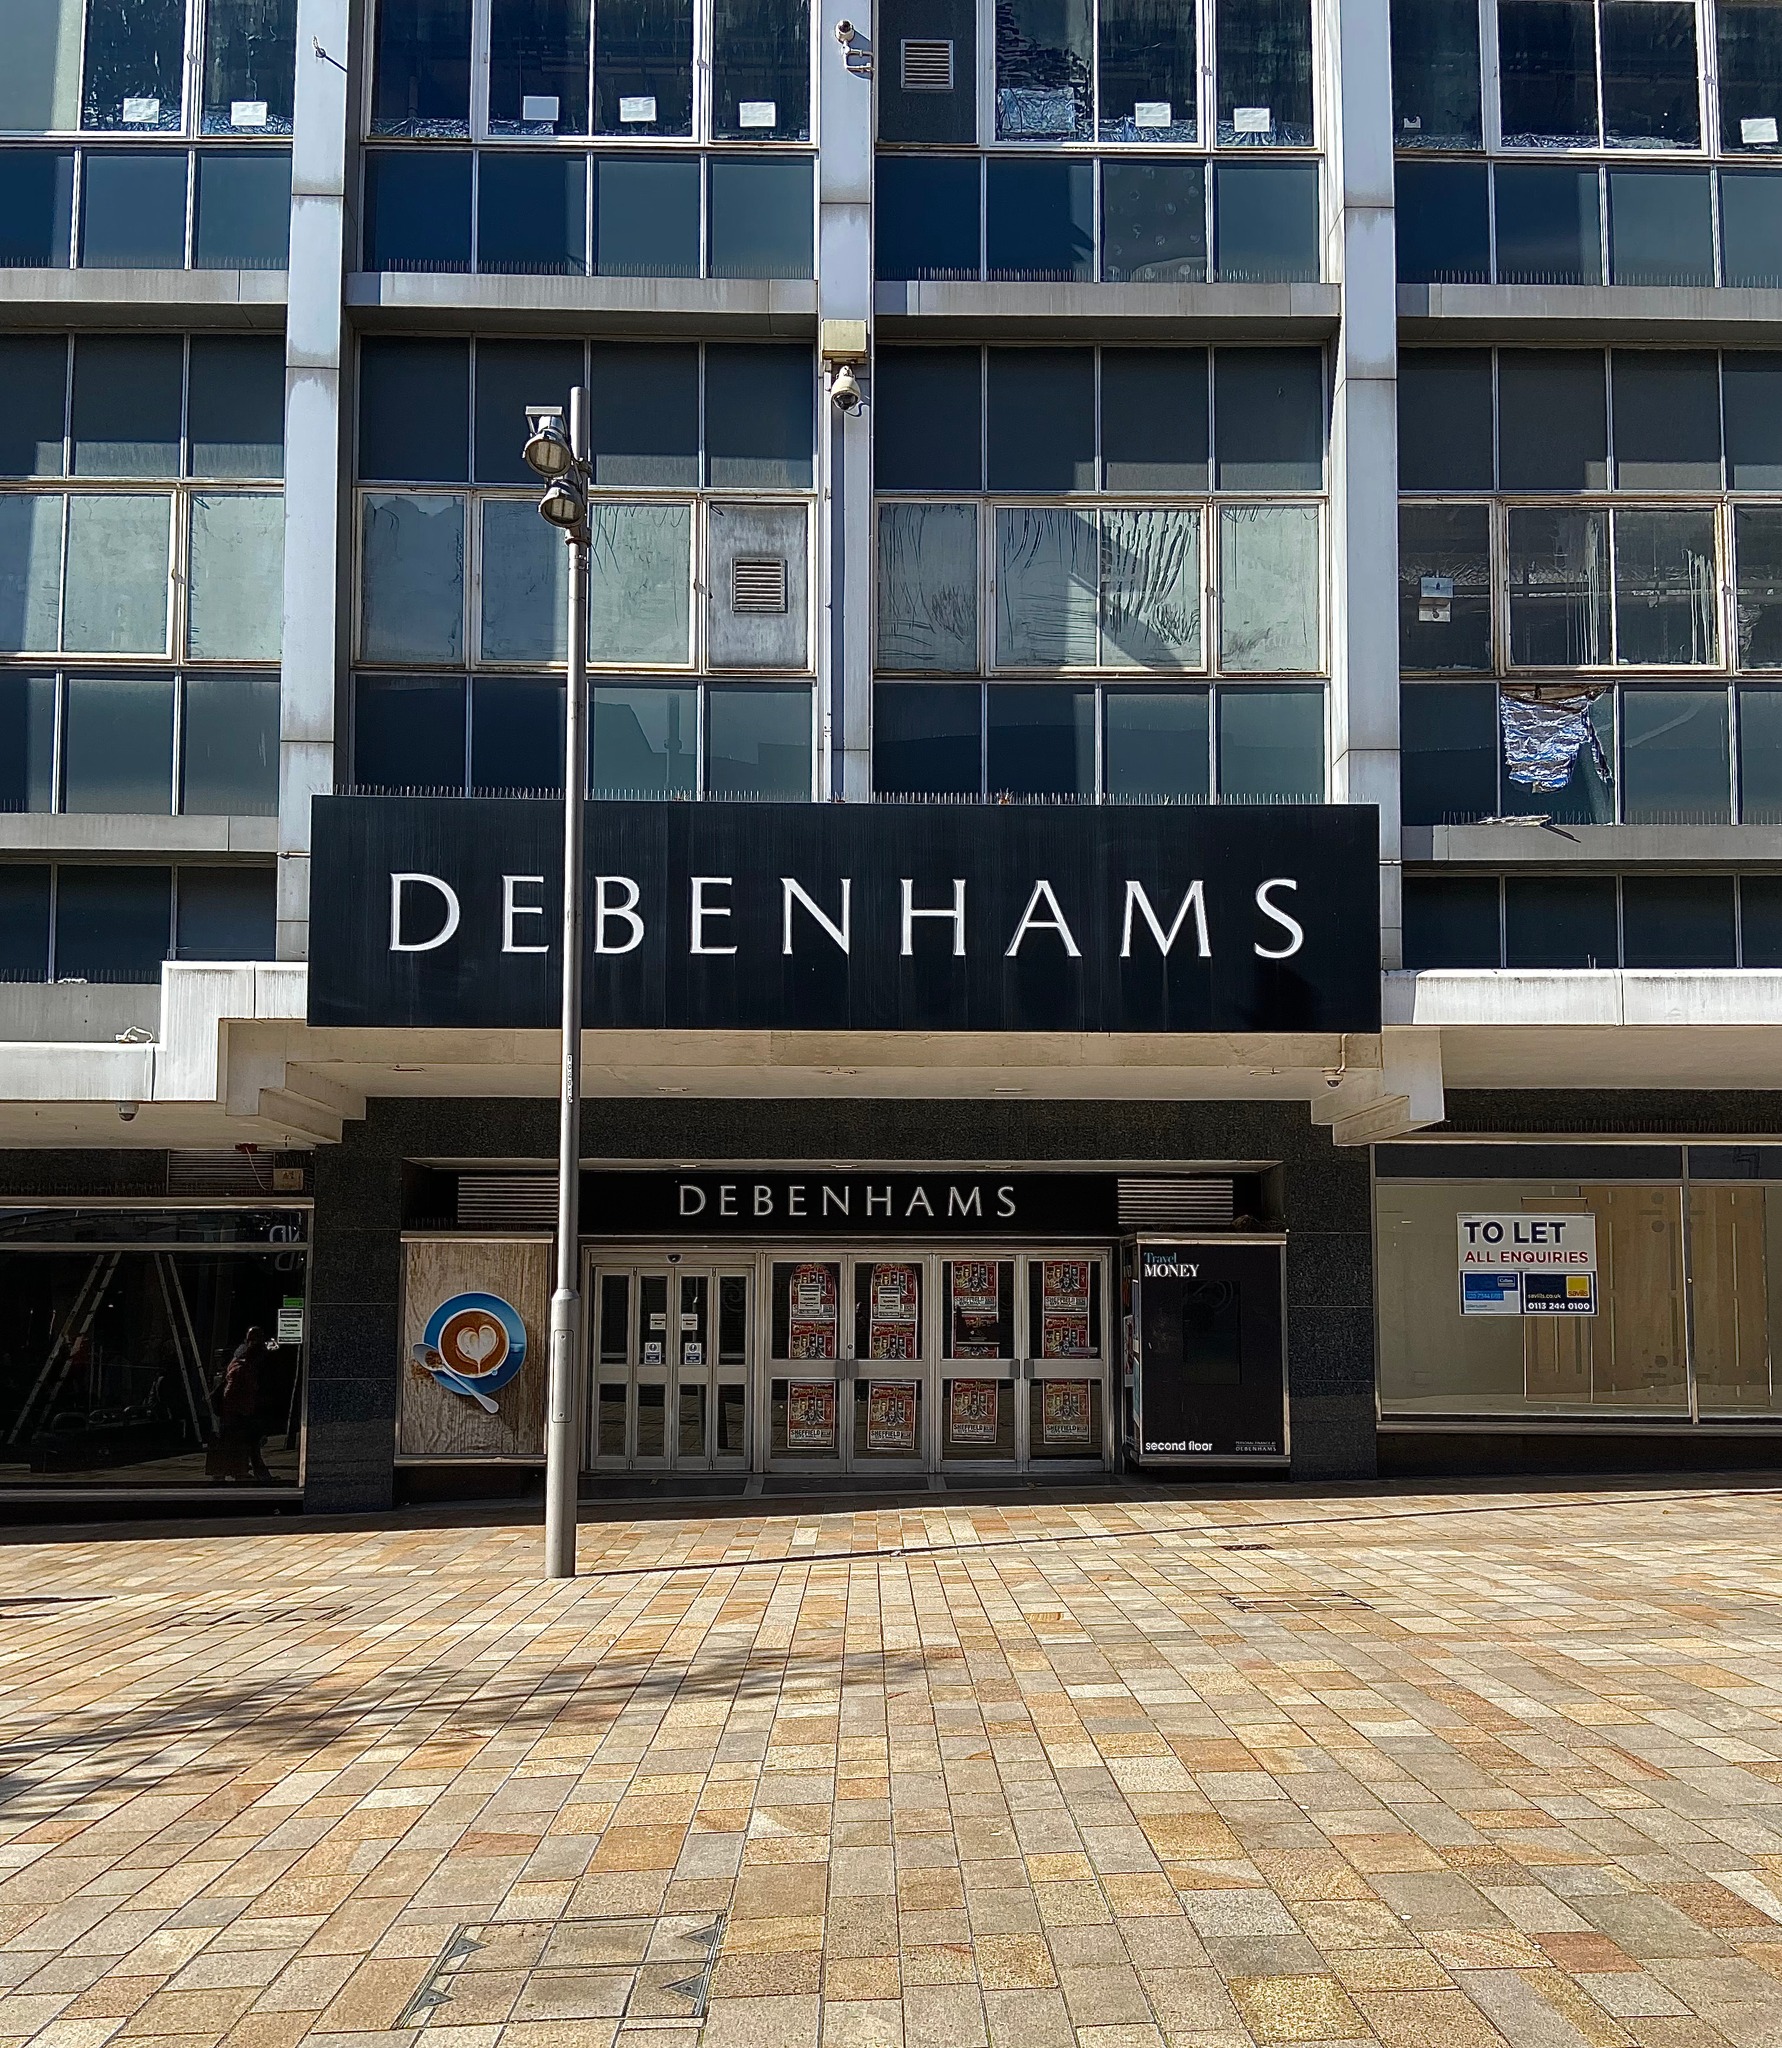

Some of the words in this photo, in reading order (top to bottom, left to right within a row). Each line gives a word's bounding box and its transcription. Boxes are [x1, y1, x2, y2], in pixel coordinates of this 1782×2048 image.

[389, 872, 1306, 961] DEBENHAMS
[678, 1184, 1017, 1219] DEBENHAMS
[1463, 1221, 1504, 1244] TO
[1513, 1221, 1567, 1244] LET
[1143, 1252, 1177, 1263] Travel
[1464, 1251, 1495, 1263] ALL
[1500, 1251, 1589, 1264] ENQUIRIES
[1143, 1264, 1200, 1277] MONEY
[1528, 1302, 1547, 1310] 0113
[1549, 1302, 1566, 1310] 244
[1568, 1302, 1590, 1310] 0100
[1145, 1440, 1186, 1451] second
[1188, 1440, 1213, 1451] floor
